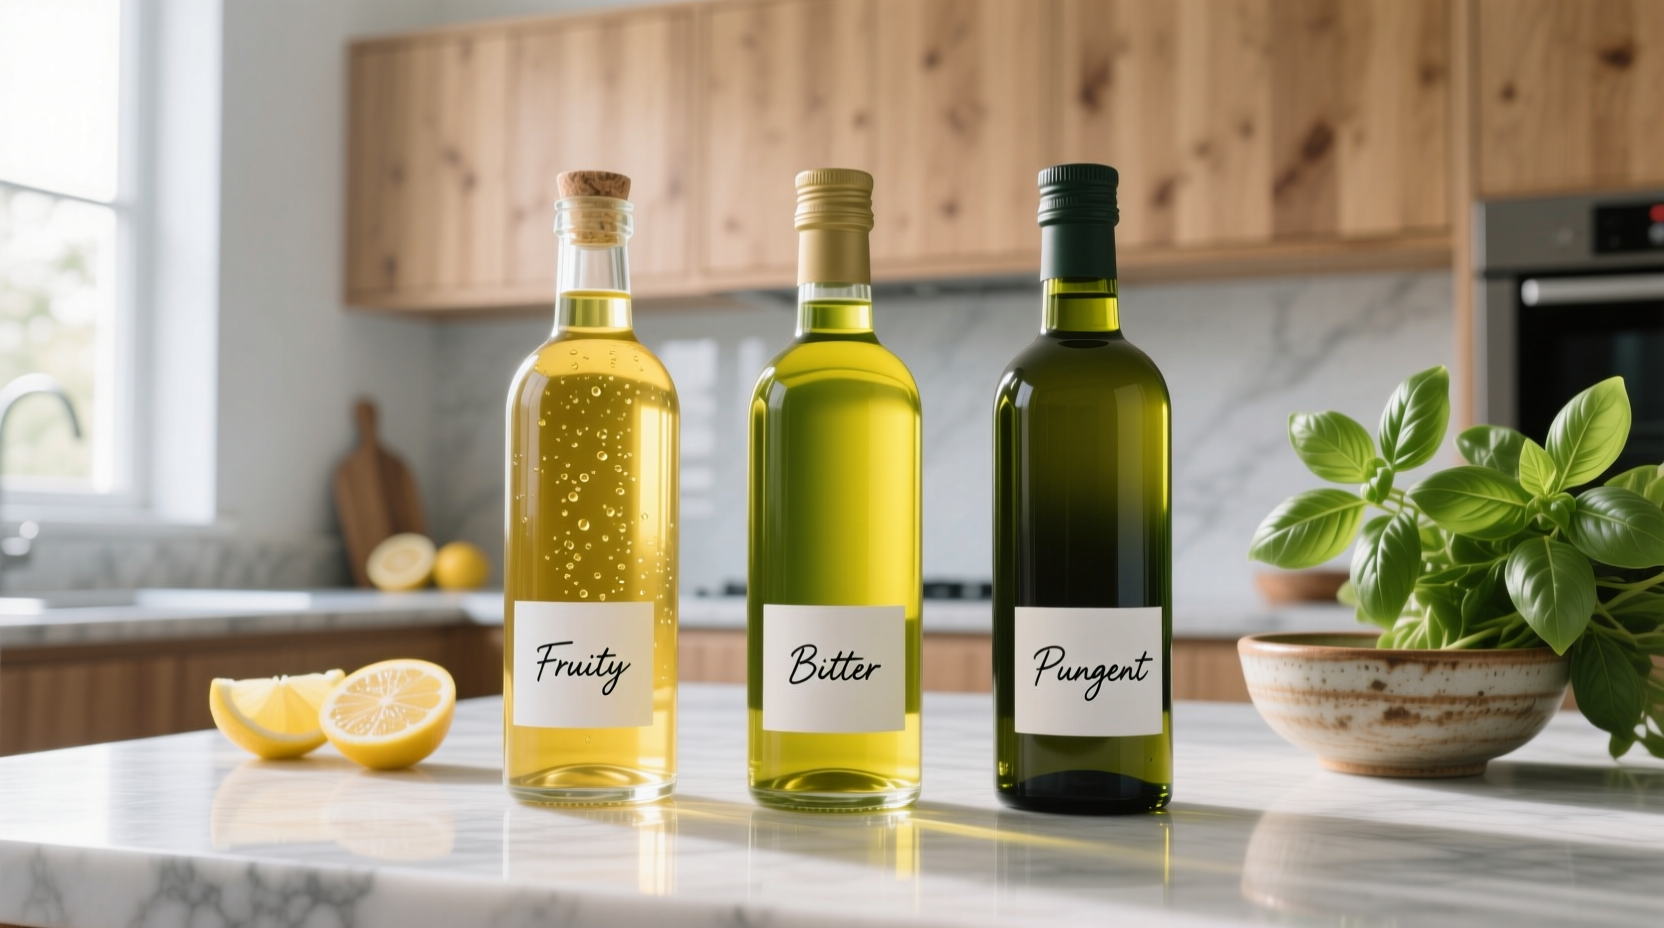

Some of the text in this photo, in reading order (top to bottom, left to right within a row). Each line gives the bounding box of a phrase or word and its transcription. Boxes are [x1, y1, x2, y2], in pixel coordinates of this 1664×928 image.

[536, 640, 631, 696] Fruity
[788, 643, 882, 685] Bitter
[1033, 645, 1154, 702] Pungent
